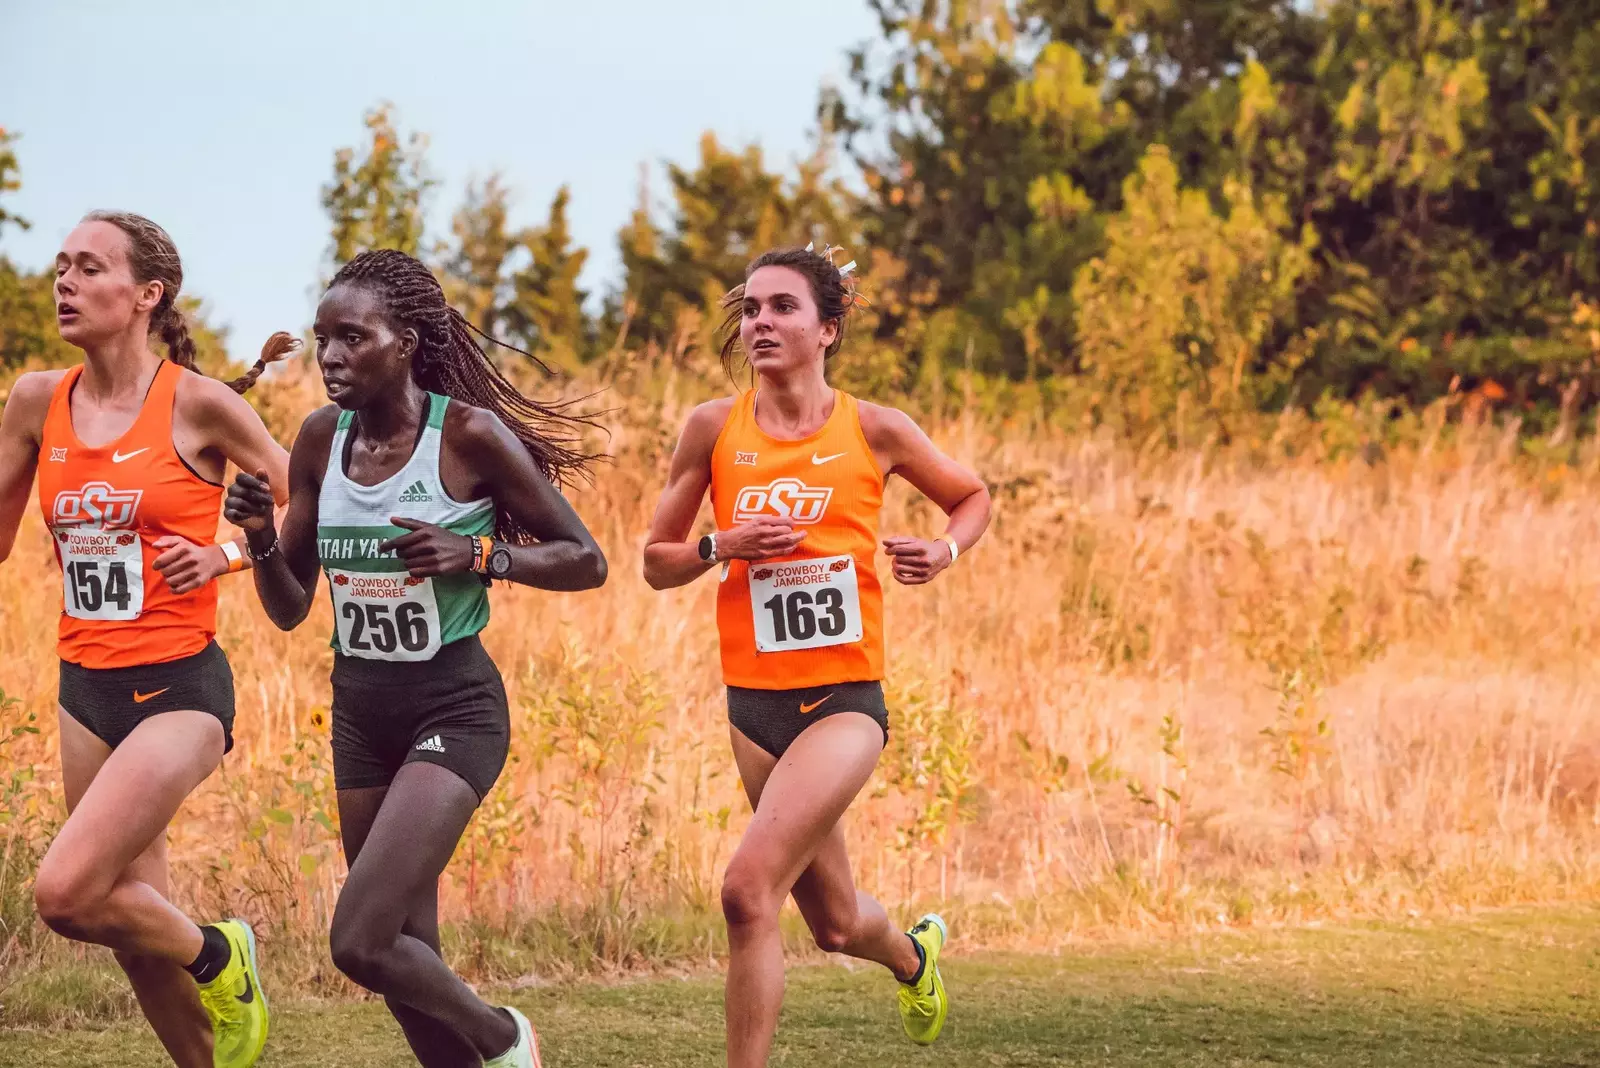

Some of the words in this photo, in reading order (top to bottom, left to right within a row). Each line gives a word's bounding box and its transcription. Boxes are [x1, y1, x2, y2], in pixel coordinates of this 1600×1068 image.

[54, 482, 143, 528] OSU
[399, 494, 432, 503] adidas
[733, 478, 833, 524] OSU
[70, 535, 111, 545] COWBOY
[69, 546, 117, 555] JAMBOREE
[776, 564, 825, 578] COWBOY
[67, 560, 131, 612] 154
[352, 578, 398, 587] COWBOY
[773, 573, 832, 588] JAMBOREE
[350, 587, 407, 598] JAMBOREE
[764, 587, 847, 642] 163
[342, 602, 429, 653] 256
